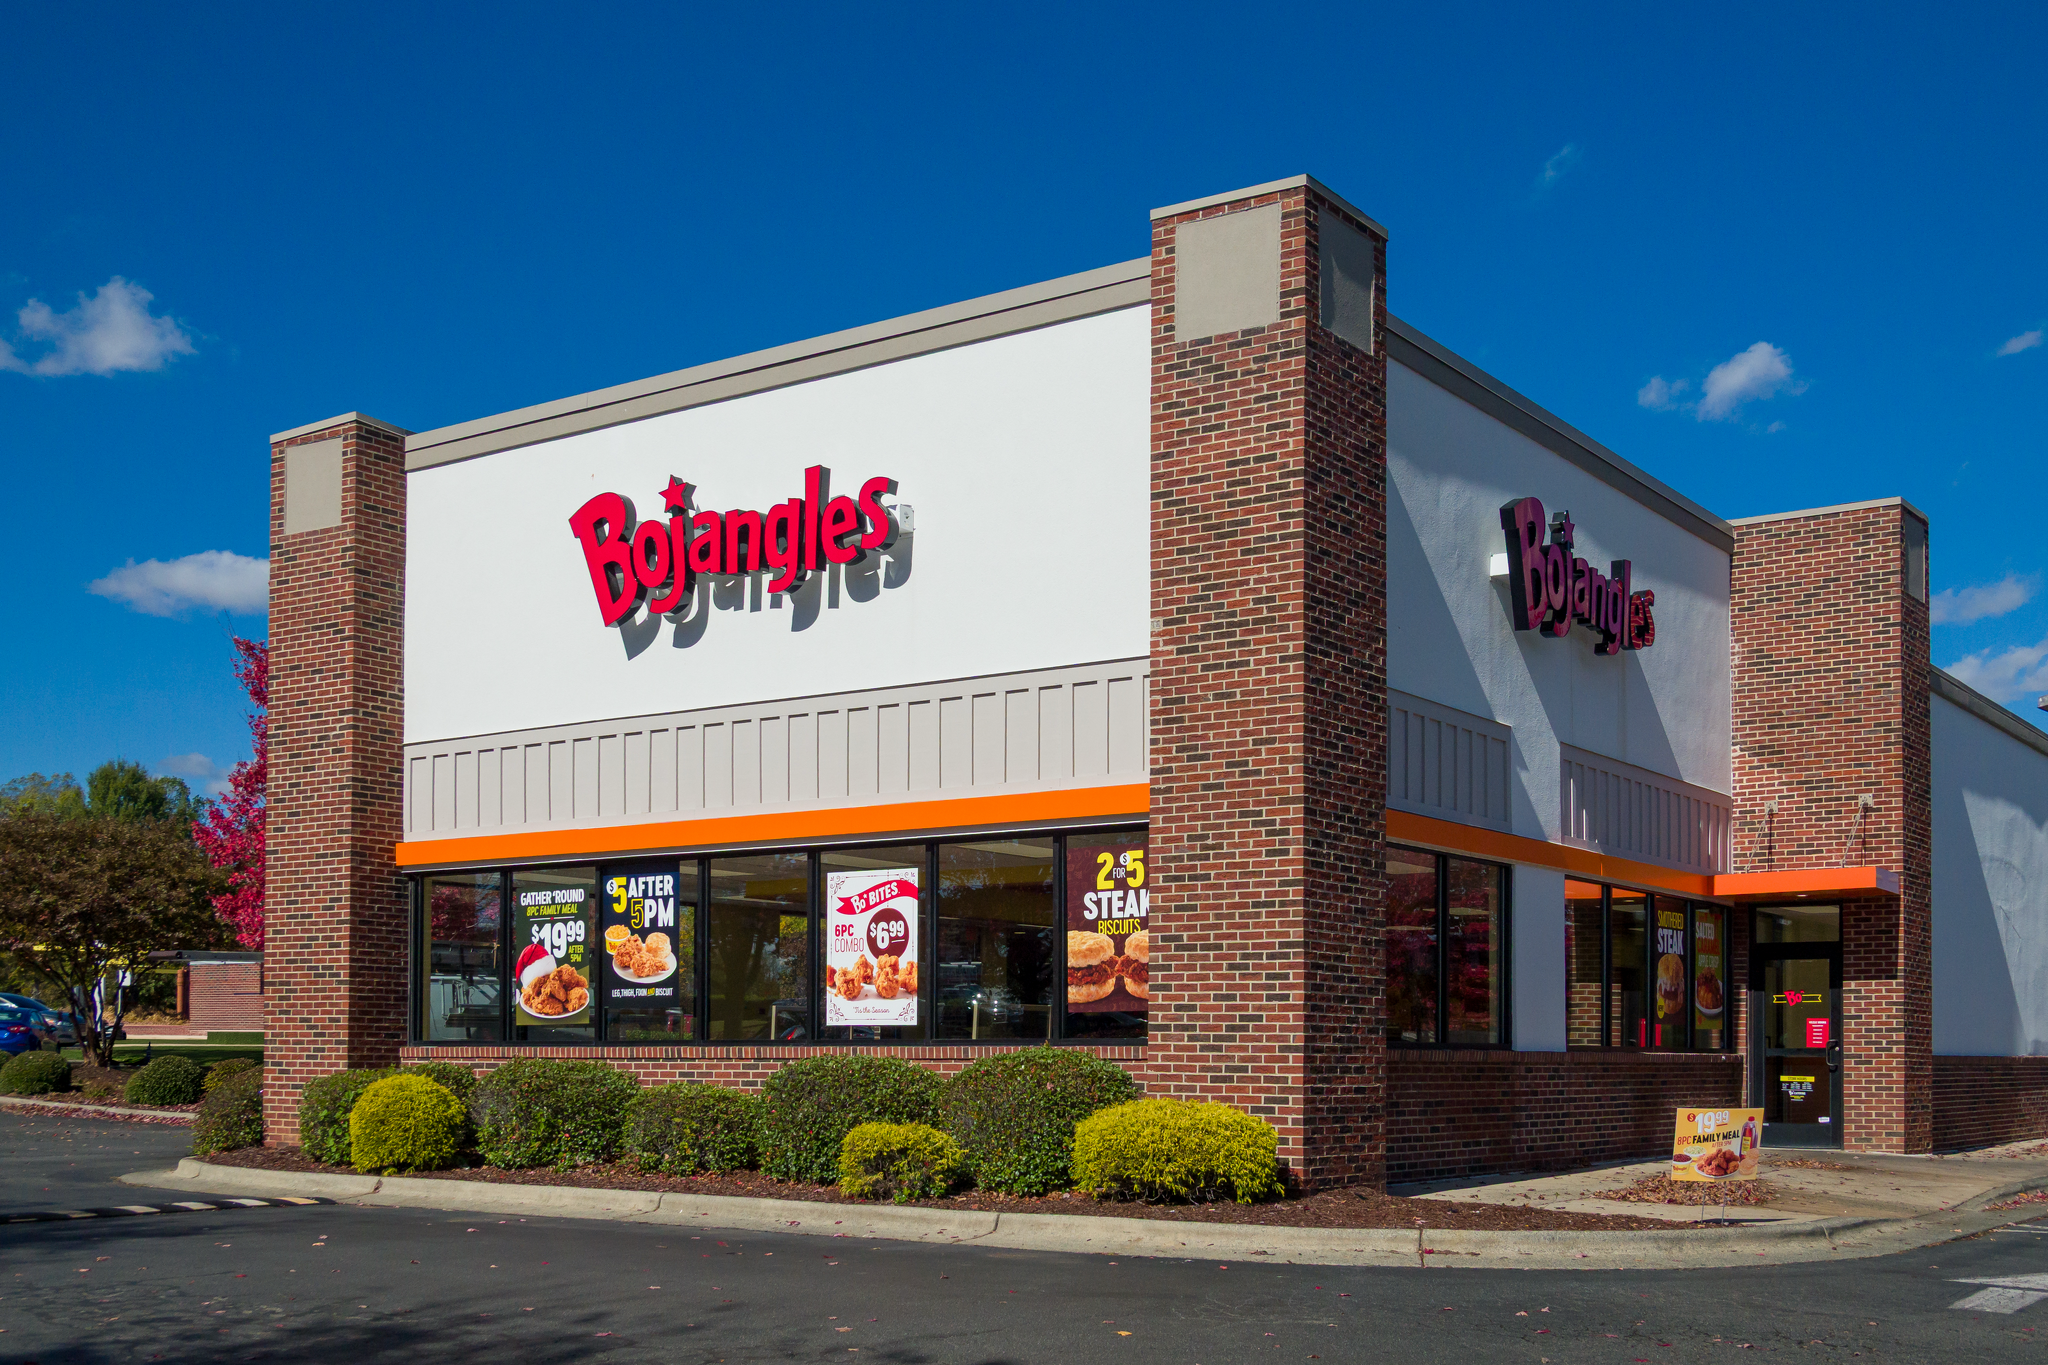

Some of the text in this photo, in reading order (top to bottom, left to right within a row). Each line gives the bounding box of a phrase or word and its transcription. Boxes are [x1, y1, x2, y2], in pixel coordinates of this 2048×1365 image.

[568, 464, 898, 628] Bojangles
[1500, 496, 1655, 656] Bojangles
[1096, 852, 1115, 890] 2
[1112, 867, 1126, 879] FOR
[627, 874, 674, 898] AFTER
[868, 881, 899, 906] BITES
[520, 891, 552, 906] GATHER
[1083, 888, 1150, 920] STEAK
[526, 903, 578, 917] 8PC FAMILY MEAL
[630, 897, 675, 929] 5PM
[1657, 909, 1684, 930] SMOTHERED
[834, 924, 854, 937] 6PC
[1098, 918, 1141, 935] BISCUITS
[1695, 921, 1715, 940] SALTED
[568, 944, 584, 954] AFTER
[834, 938, 865, 953] COMBO
[1657, 927, 1684, 956] STEAK
[570, 953, 582, 962] 5PM
[655, 987, 673, 996] BISCUIT
[1677, 1129, 1740, 1146] 8PC FAMILY MEAL
